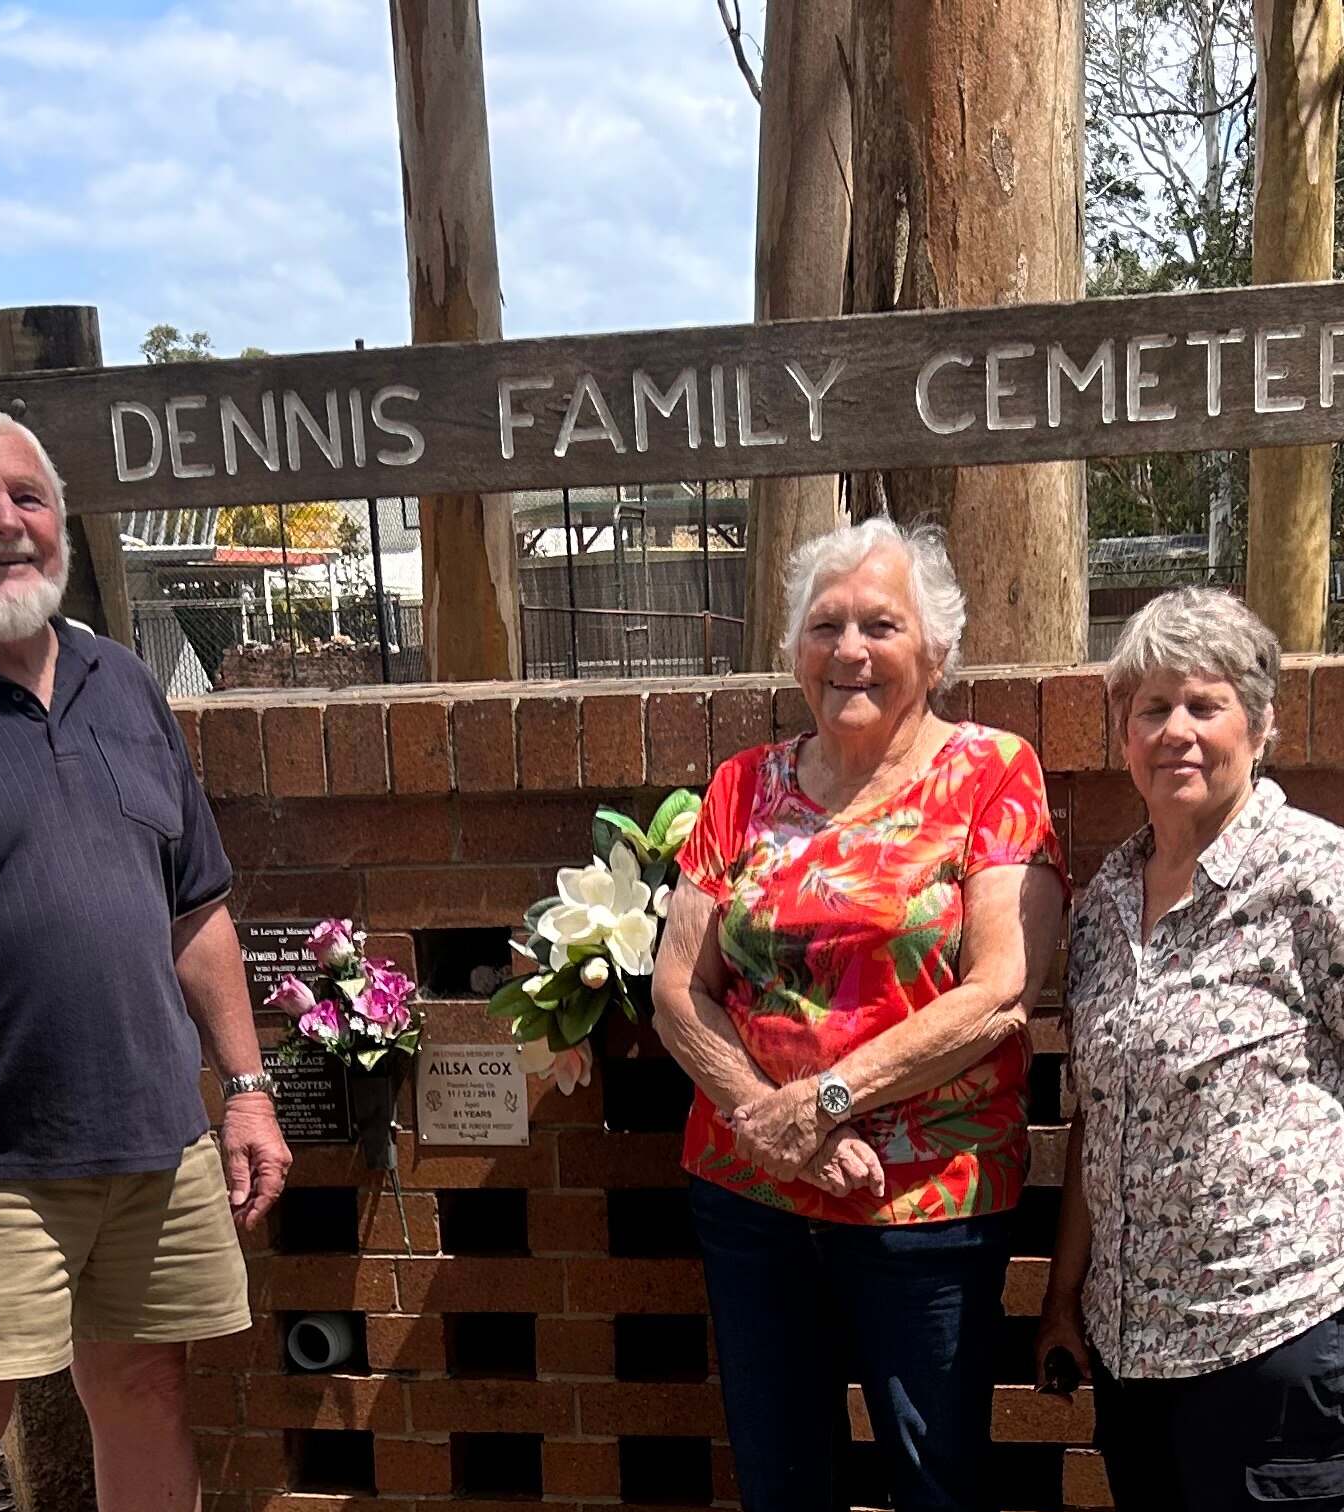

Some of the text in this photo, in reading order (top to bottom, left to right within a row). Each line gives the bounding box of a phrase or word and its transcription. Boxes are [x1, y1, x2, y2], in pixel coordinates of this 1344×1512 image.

[110, 384, 425, 483] DENNIS
[498, 358, 847, 459] FAMILY
[293, 1056, 325, 1067] PLACE
[428, 1062, 512, 1075] AILSA COX
